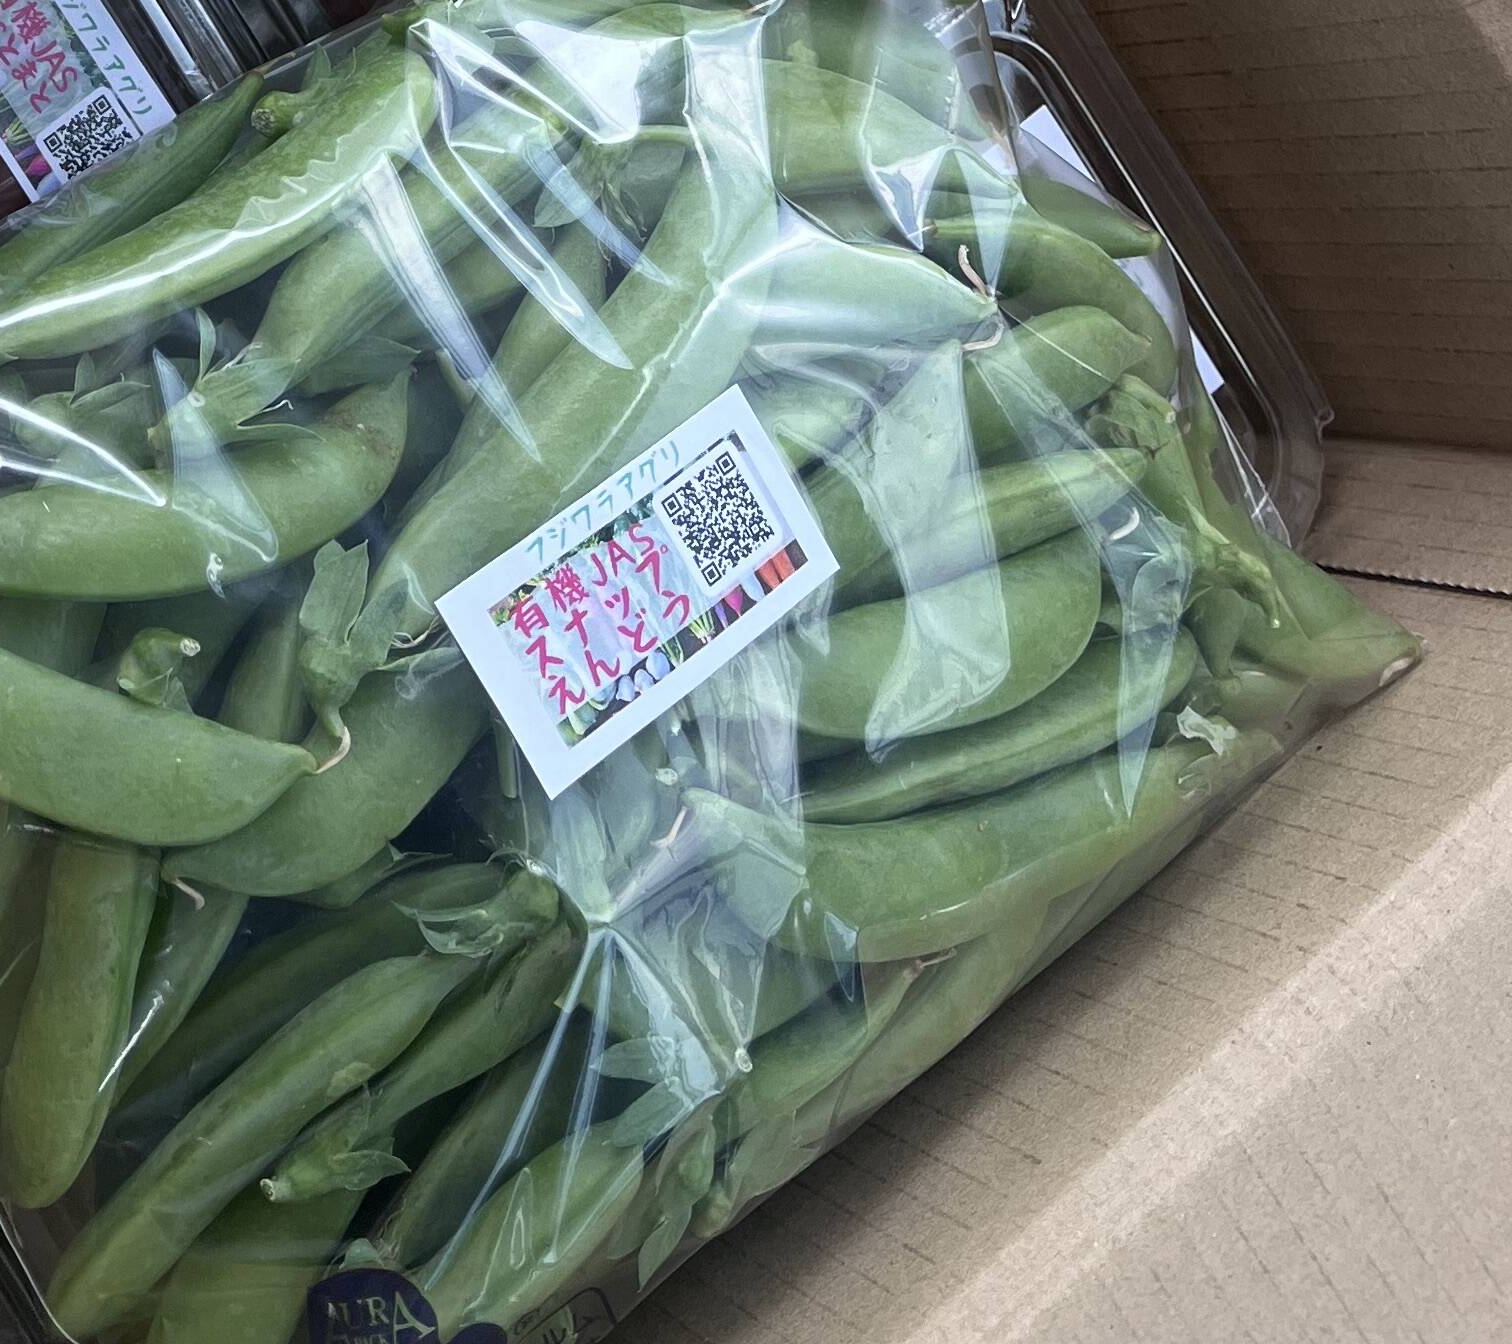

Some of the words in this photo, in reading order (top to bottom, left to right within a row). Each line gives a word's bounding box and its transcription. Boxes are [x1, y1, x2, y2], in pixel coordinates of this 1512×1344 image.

[526, 441, 681, 563] フジワラアグリ
[509, 521, 650, 635] 有機JAS
[526, 544, 668, 679] スナップ
[548, 589, 692, 715] えんどう
